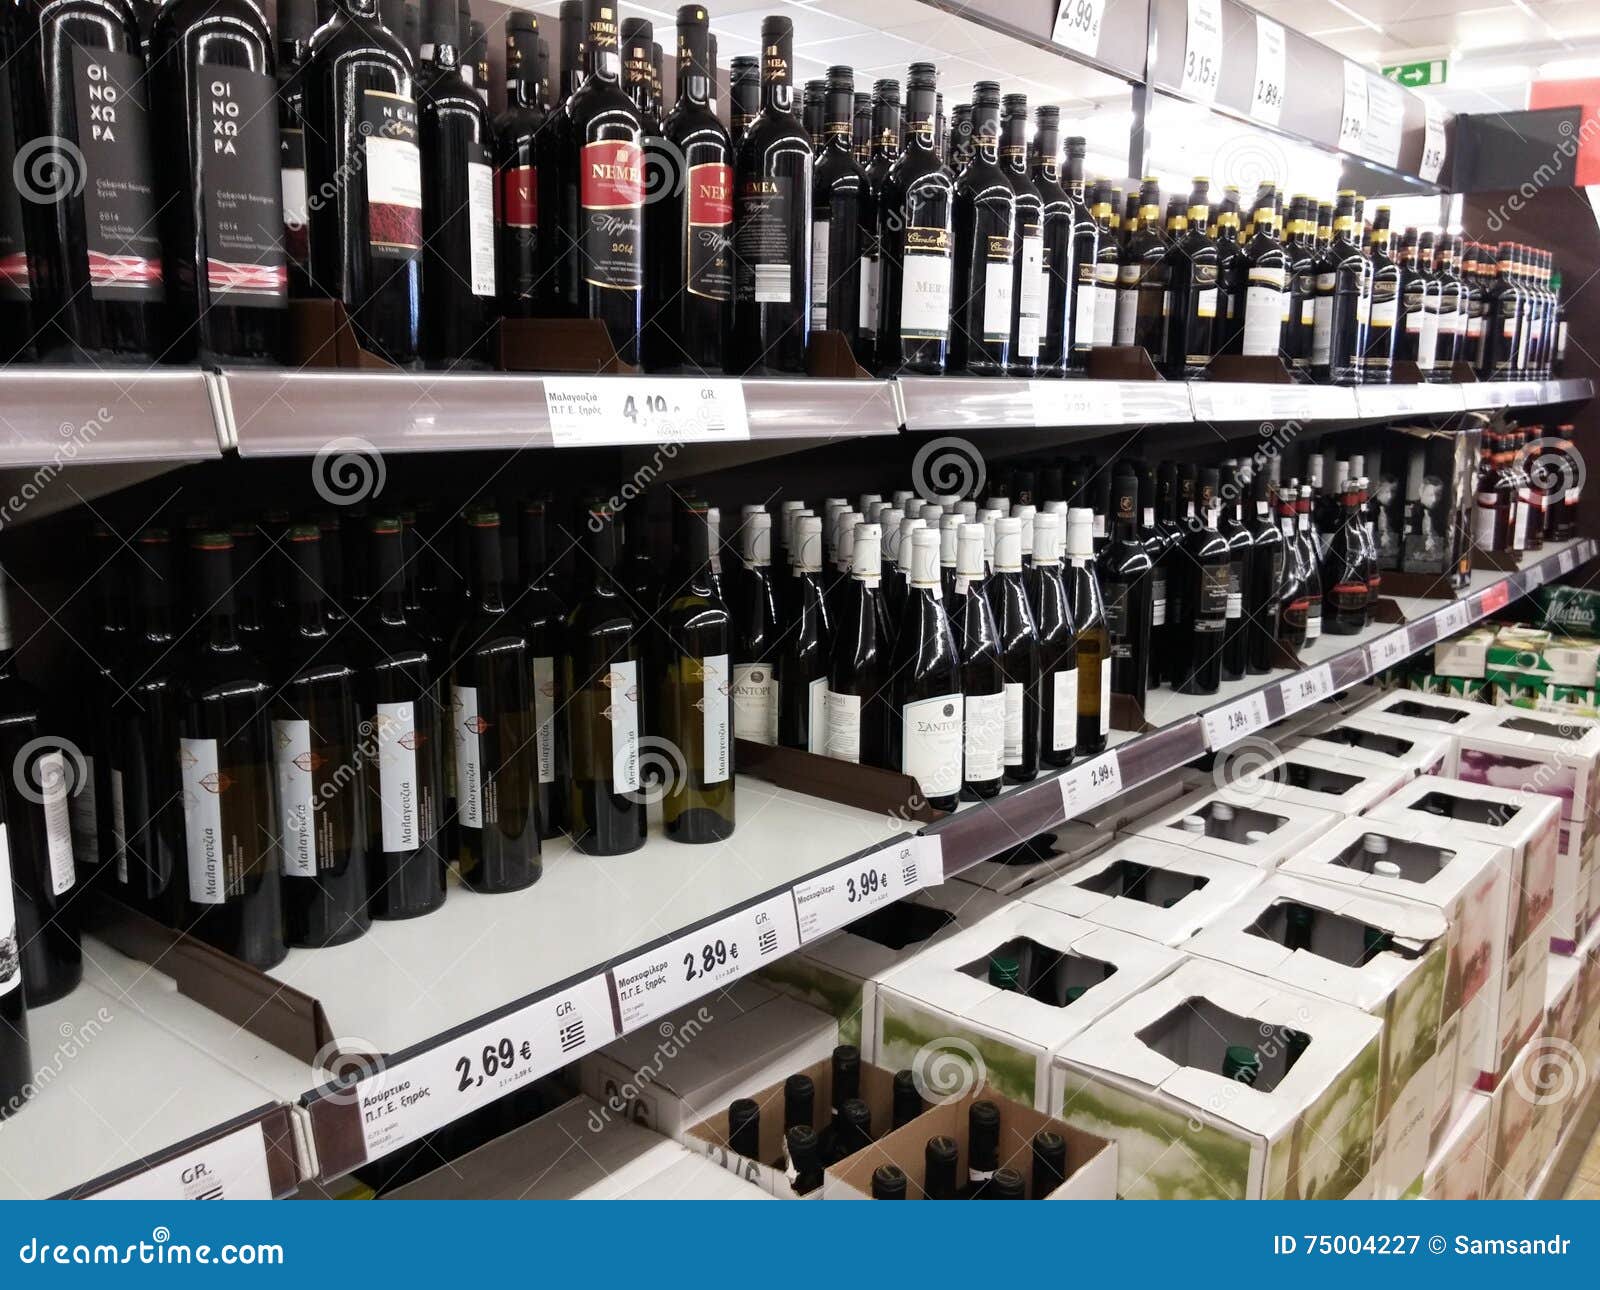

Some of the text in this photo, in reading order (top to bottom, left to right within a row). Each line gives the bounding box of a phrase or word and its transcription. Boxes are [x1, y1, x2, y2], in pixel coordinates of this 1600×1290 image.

[611, 242, 634, 256] 2014
[733, 686, 770, 697] ΑΝΤΟΡΙ
[1091, 763, 1109, 787] 2,99
[846, 868, 879, 904] 3,99
[880, 873, 888, 889] €
[754, 911, 771, 926] GR.
[683, 939, 739, 982] 2,89 €
[618, 960, 669, 989] Μοσχοφίλερο
[555, 1000, 577, 1017] GR.
[455, 1037, 533, 1093] 2,69 €
[363, 1080, 411, 1109] Ασύρτικο
[365, 1086, 431, 1124] Π.Γ.Ε. ξηρός
[180, 1162, 213, 1186] GR.
